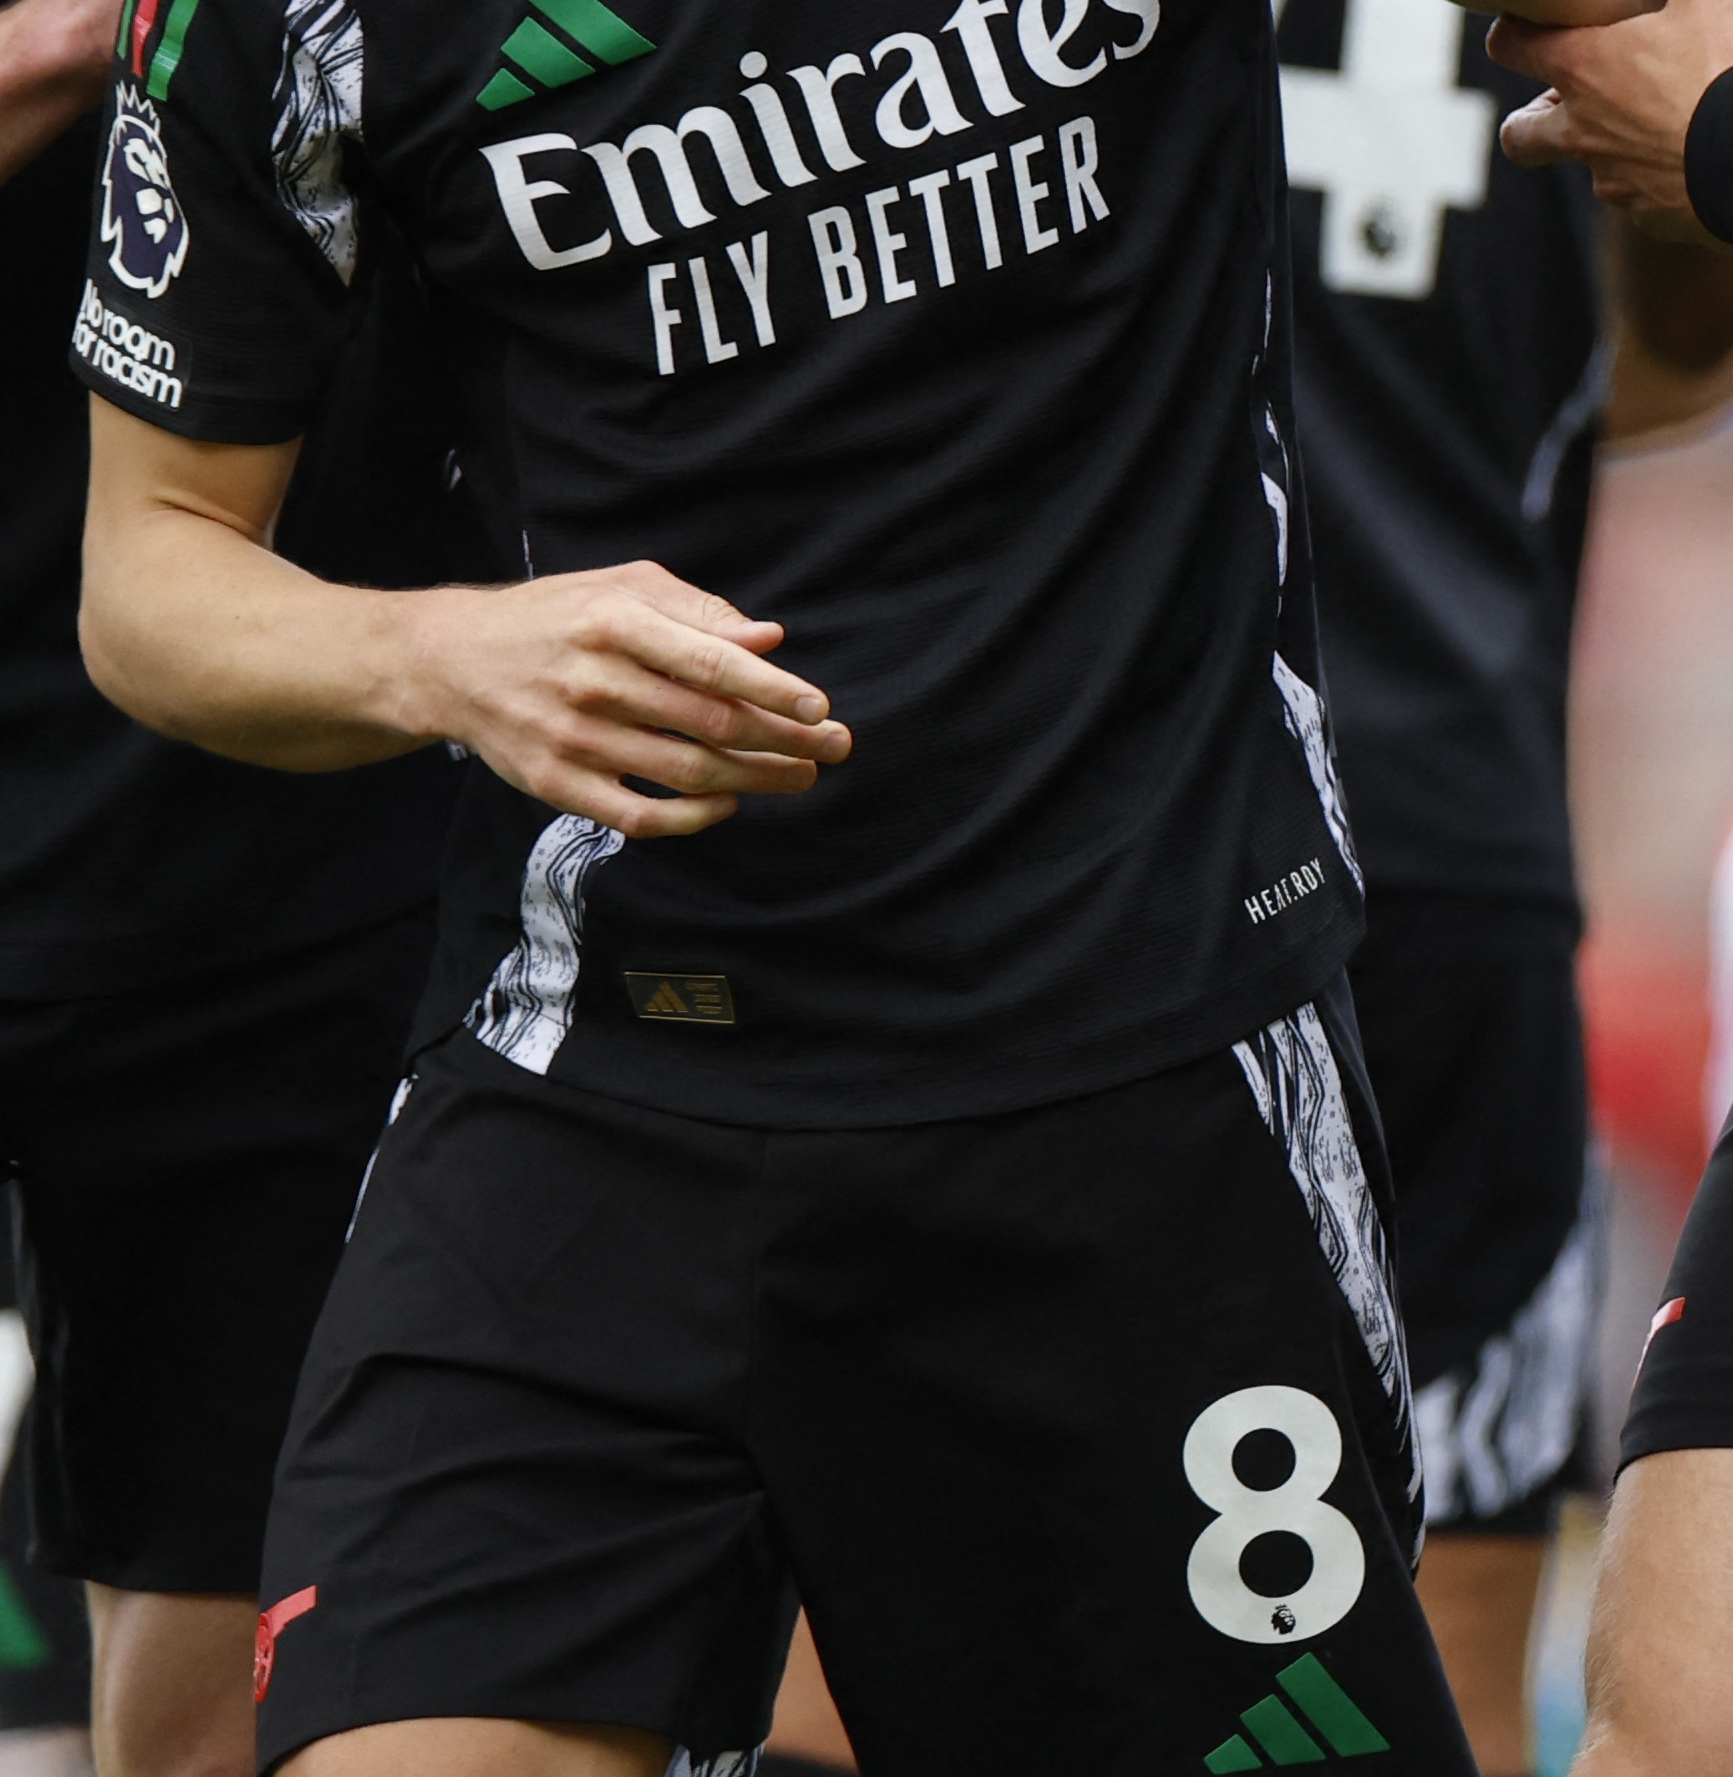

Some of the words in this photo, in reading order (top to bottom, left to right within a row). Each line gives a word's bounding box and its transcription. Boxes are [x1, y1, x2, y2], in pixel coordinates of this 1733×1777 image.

[647, 230, 776, 375] FLY
[808, 116, 1111, 319] BETTER
[71, 311, 98, 358] for
[92, 338, 182, 408] racism
[80, 278, 103, 328] No
[102, 309, 176, 370] room
[1244, 857, 1325, 924] HEAT.RDY
[1182, 1385, 1366, 1644] 8
